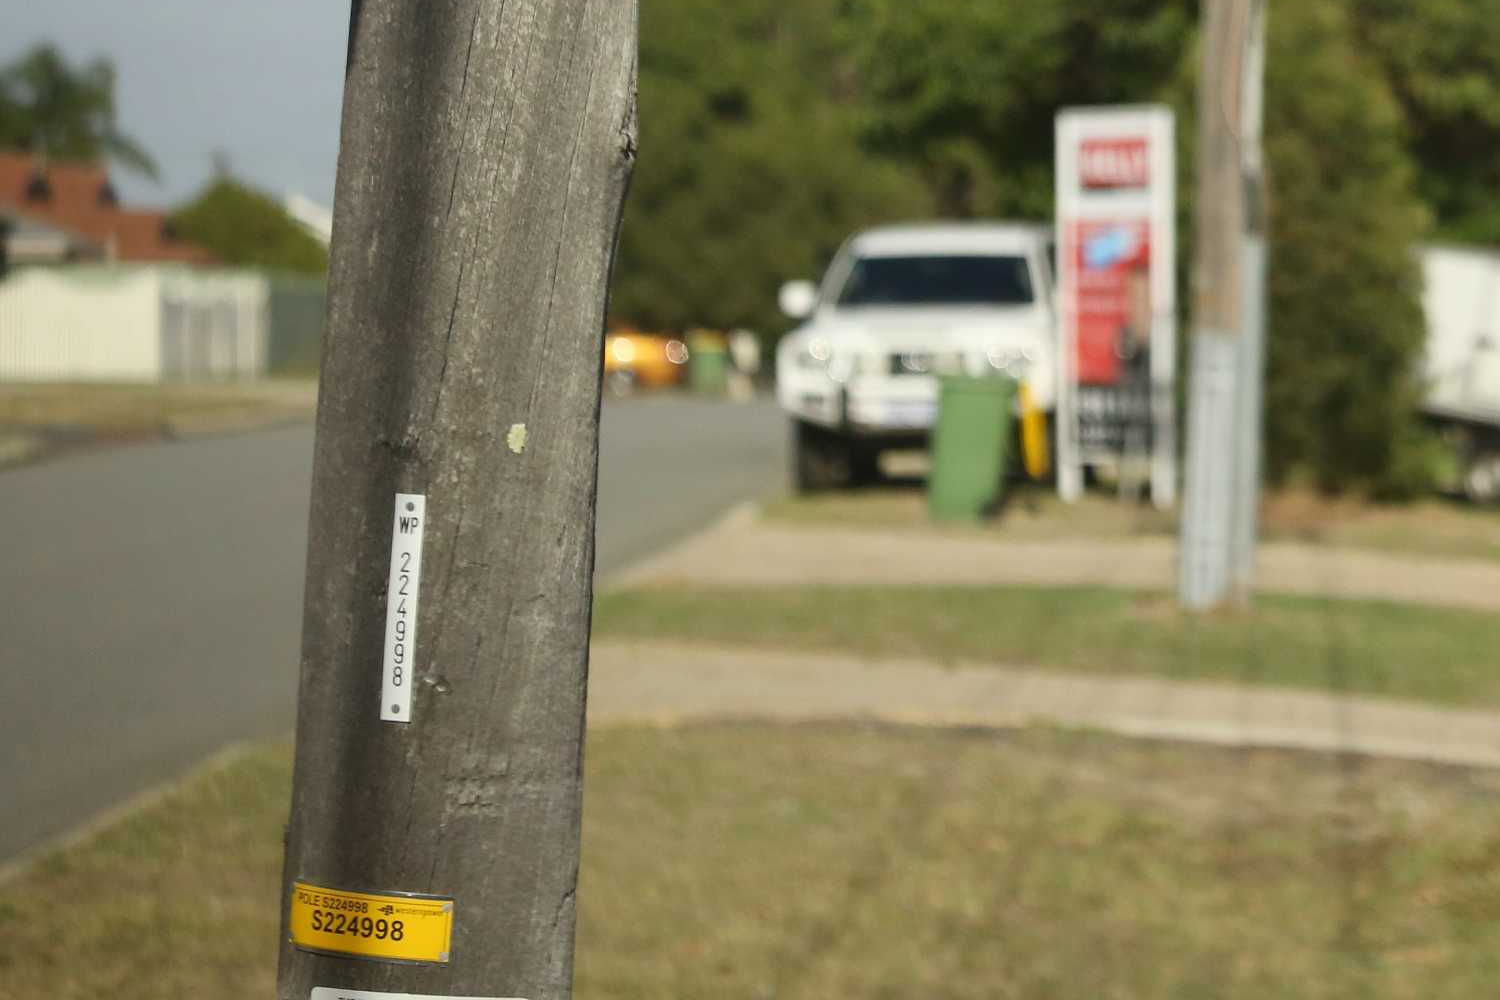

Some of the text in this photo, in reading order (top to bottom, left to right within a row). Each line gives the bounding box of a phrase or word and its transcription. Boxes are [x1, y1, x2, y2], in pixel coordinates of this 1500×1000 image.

[399, 517, 418, 534] WP
[299, 892, 319, 907] POLE
[322, 896, 368, 914] S224998
[312, 910, 404, 941] S224998
